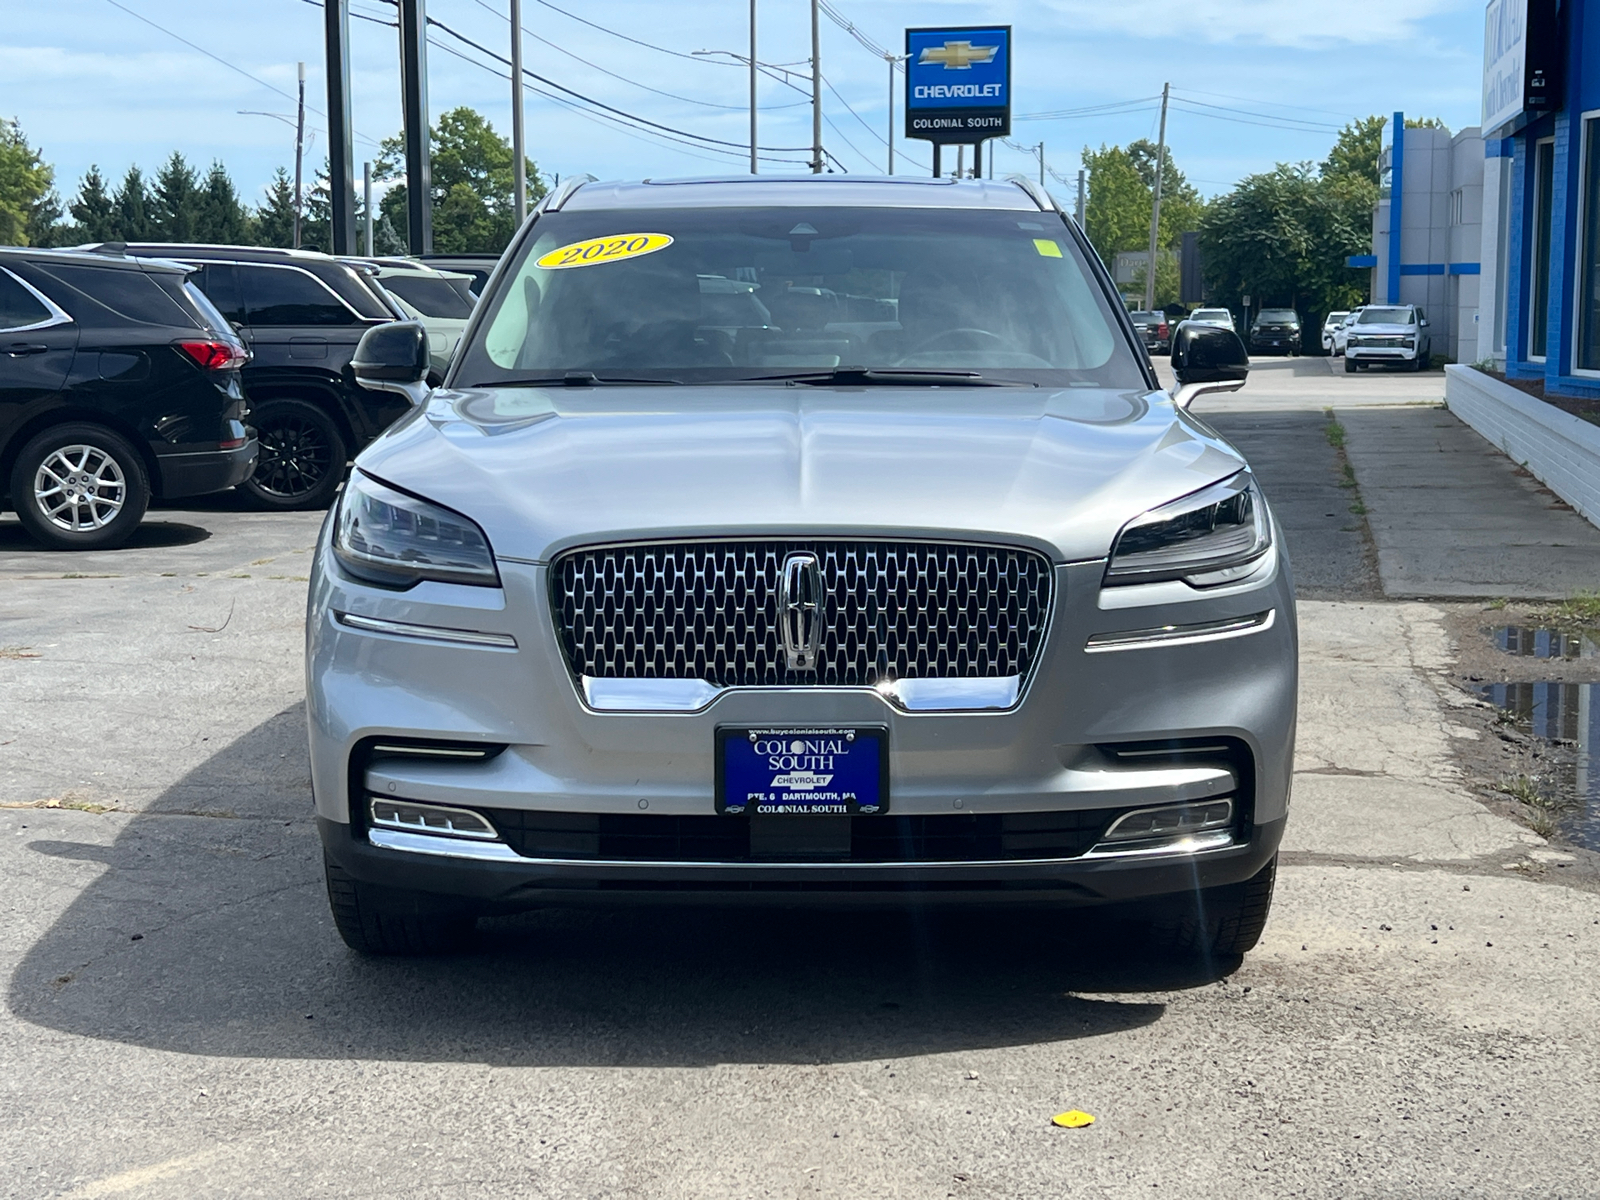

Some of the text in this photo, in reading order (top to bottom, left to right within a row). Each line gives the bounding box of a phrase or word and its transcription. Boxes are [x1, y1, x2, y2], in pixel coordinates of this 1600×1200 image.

[914, 84, 1002, 98] CHEVROLET
[913, 117, 1002, 129] COLONIAL SOUTH
[558, 237, 649, 265] 2020
[754, 740, 849, 755] COLONIAL
[768, 755, 834, 770] SOUTH
[777, 776, 827, 784] CHEVROLET
[769, 793, 776, 801] 6
[782, 792, 840, 801] DARTMOUTH,
[757, 804, 847, 813] COLONIAL SOUTH
